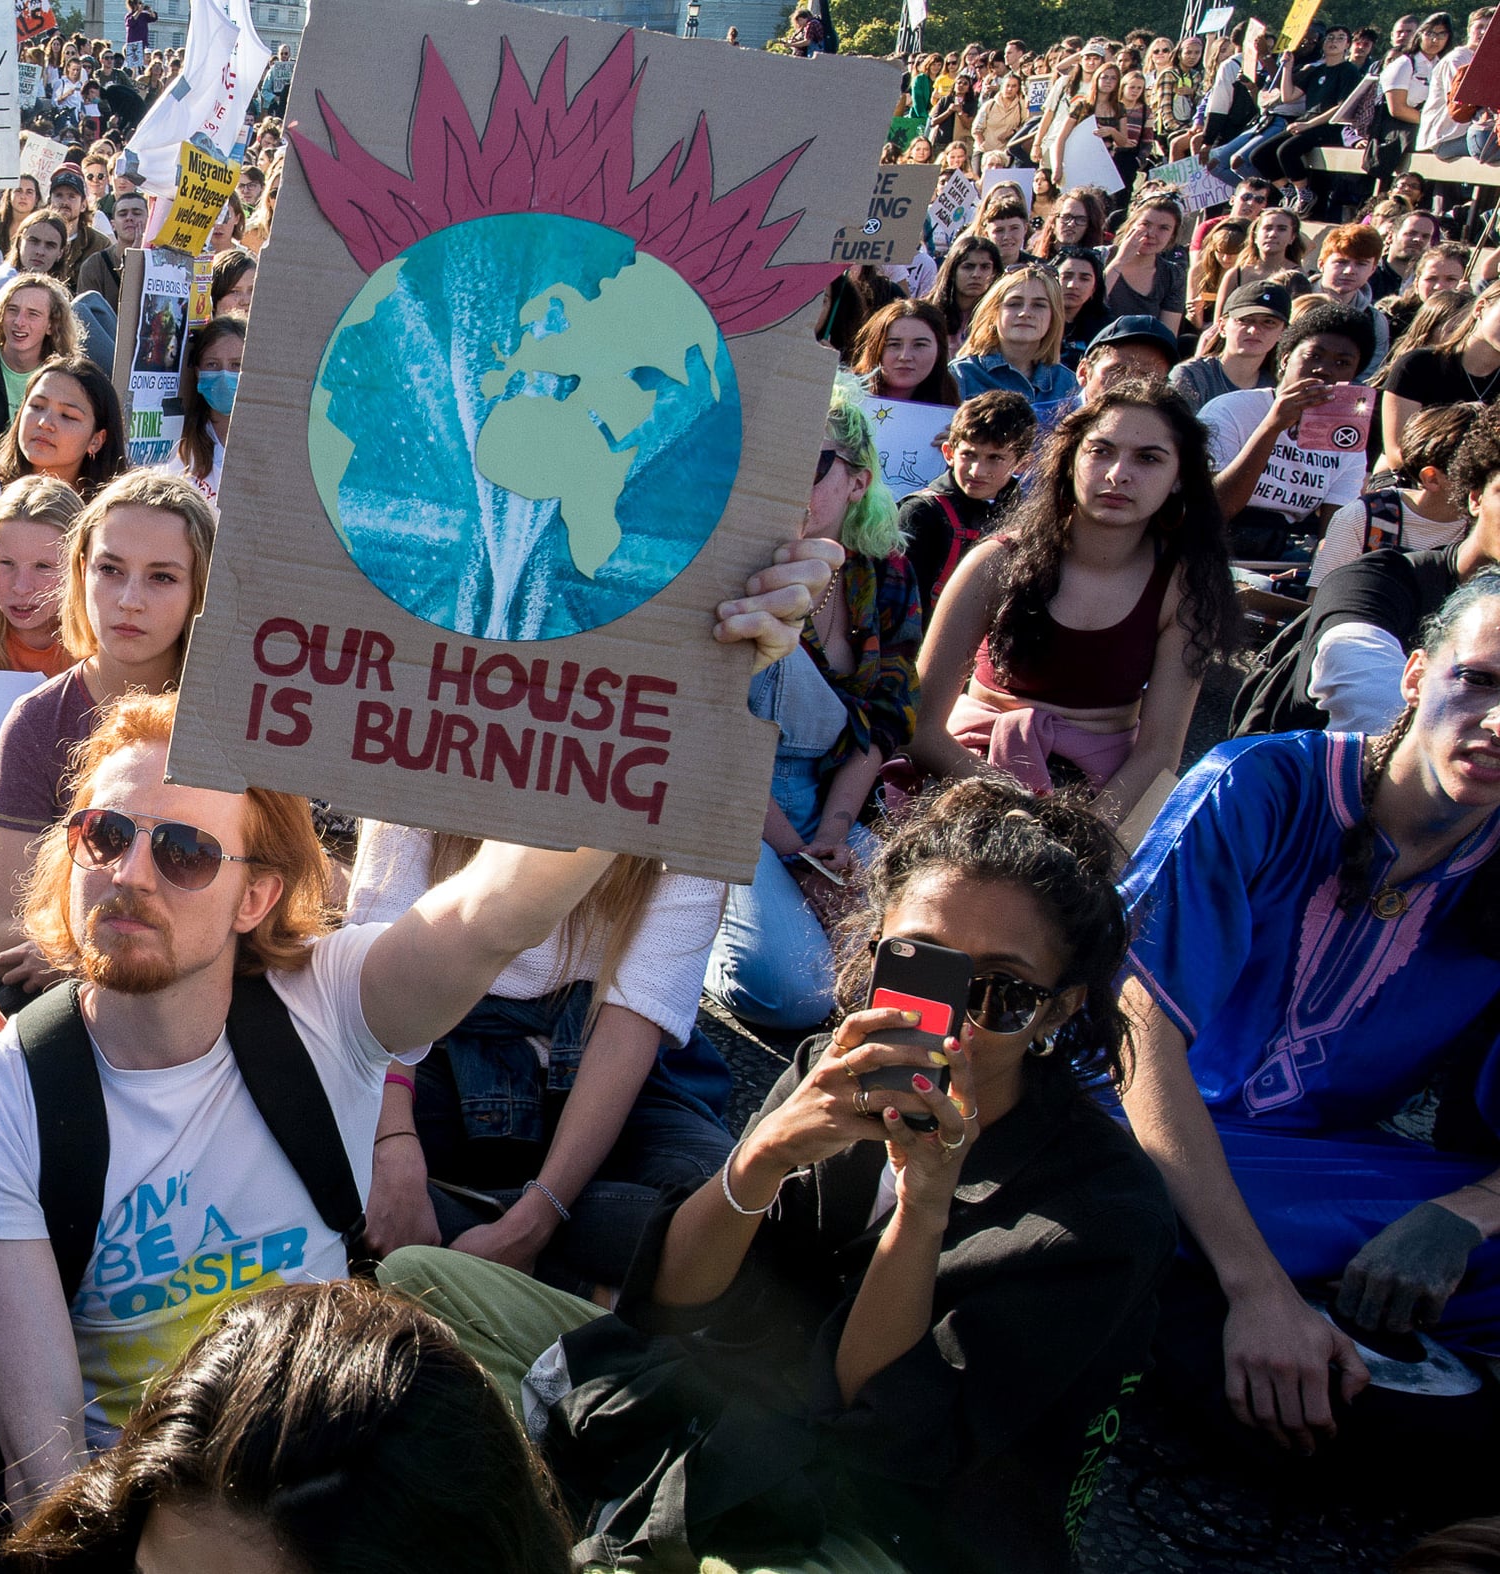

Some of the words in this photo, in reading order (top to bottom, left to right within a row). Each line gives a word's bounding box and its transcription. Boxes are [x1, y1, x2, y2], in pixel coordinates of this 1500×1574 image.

[189, 151, 233, 185] Migrants
[180, 175, 189, 198] &
[947, 186, 965, 206] EARTH
[952, 176, 971, 198] MAKE
[175, 206, 213, 230] welcome
[867, 197, 912, 219] ING
[935, 208, 953, 228] AGAIN
[171, 227, 192, 249] here
[830, 240, 895, 263] TURE!
[147, 278, 165, 292] EVEN
[131, 375, 155, 390] GOING
[157, 375, 179, 391] GREEN
[130, 411, 164, 439] STRIKE
[1253, 481, 1274, 499] HE
[1290, 470, 1325, 489] SAVE
[253, 616, 395, 692] OUR
[427, 642, 678, 743] HOUSE
[245, 683, 313, 747] IS
[351, 700, 671, 825] BURNING
[94, 1223, 181, 1287] BE
[198, 1204, 242, 1250] A
